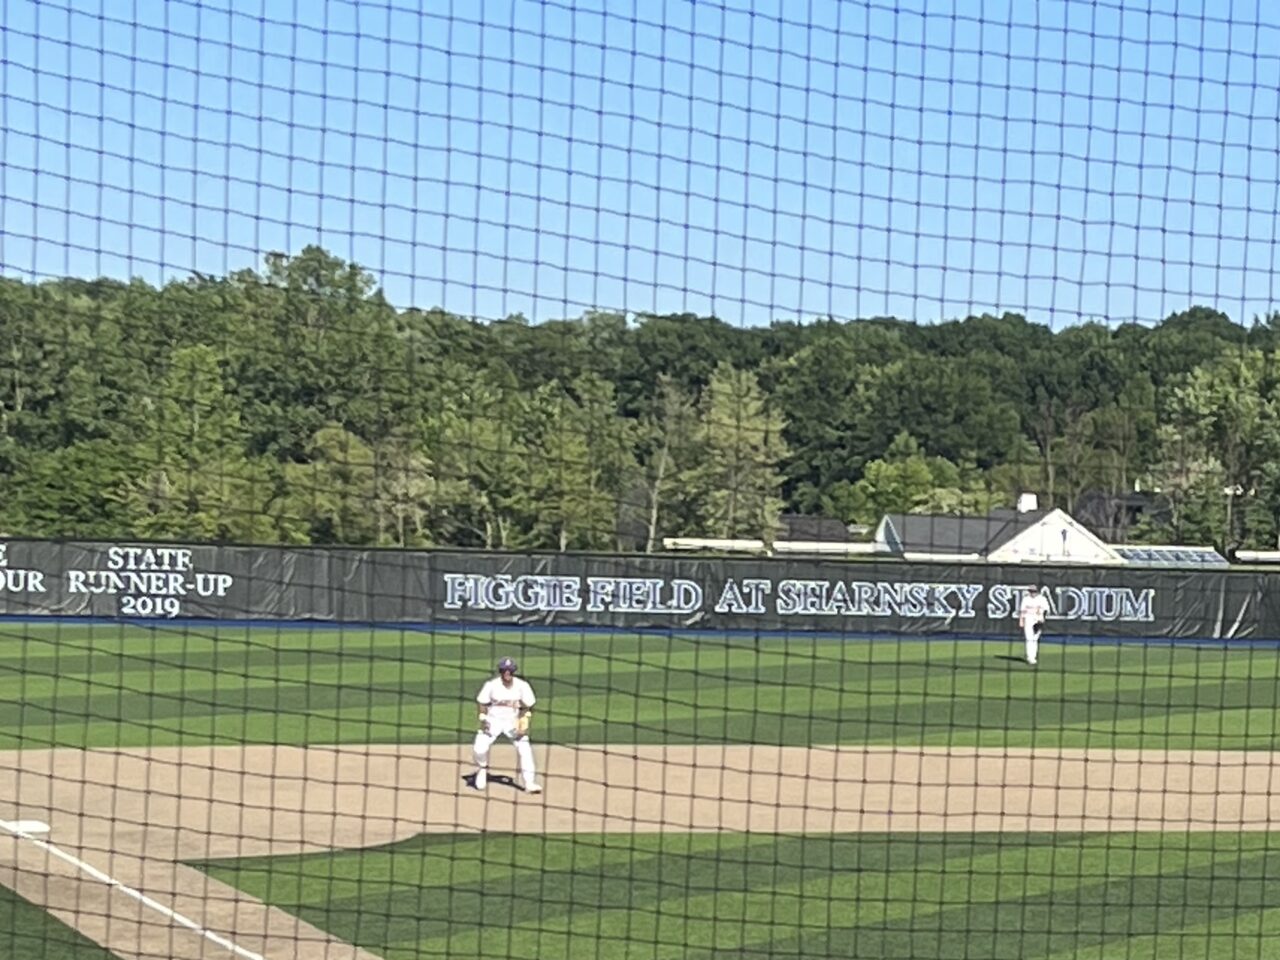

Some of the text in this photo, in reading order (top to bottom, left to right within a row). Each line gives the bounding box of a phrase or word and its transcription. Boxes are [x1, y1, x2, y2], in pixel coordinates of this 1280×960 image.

[107, 547, 193, 571] STATE
[68, 570, 233, 597] RUNNER-UP
[444, 574, 582, 611] FIGGIE
[587, 577, 703, 614] FIELD
[714, 578, 771, 614] AT
[777, 579, 983, 618] SHARNSKY
[121, 595, 181, 618] 2019
